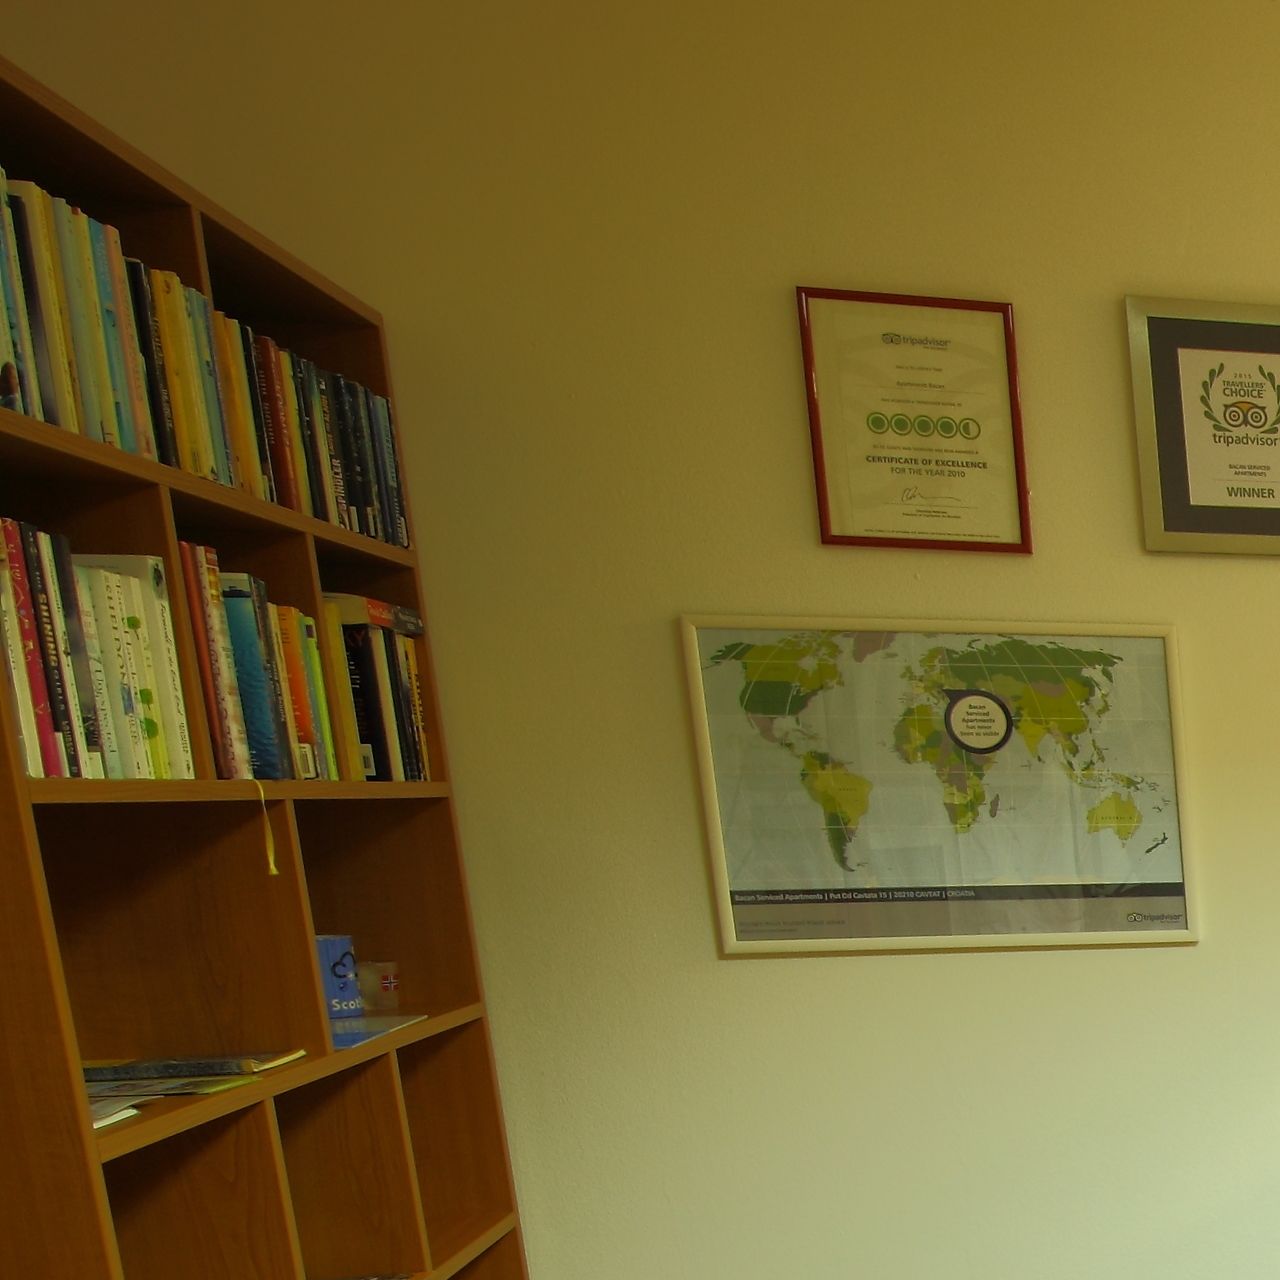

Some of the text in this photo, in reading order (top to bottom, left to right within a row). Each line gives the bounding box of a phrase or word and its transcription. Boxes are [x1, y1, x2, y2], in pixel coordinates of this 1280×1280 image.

[902, 335, 950, 348] tripadvisor
[1222, 387, 1265, 399] CHOICE
[1212, 433, 1279, 447] tripadvisor
[865, 455, 988, 469] CERTIFICATE OF EXCELLENCE
[890, 466, 966, 478] FOR THE YEAR 2010
[331, 458, 349, 513] SPINDLER
[1226, 486, 1275, 498] WINNER
[37, 592, 59, 669] SHINING
[756, 892, 784, 902] Serviced
[784, 892, 824, 902] Apartments
[915, 890, 941, 899] CAVTAT
[947, 889, 977, 898] CROATIA
